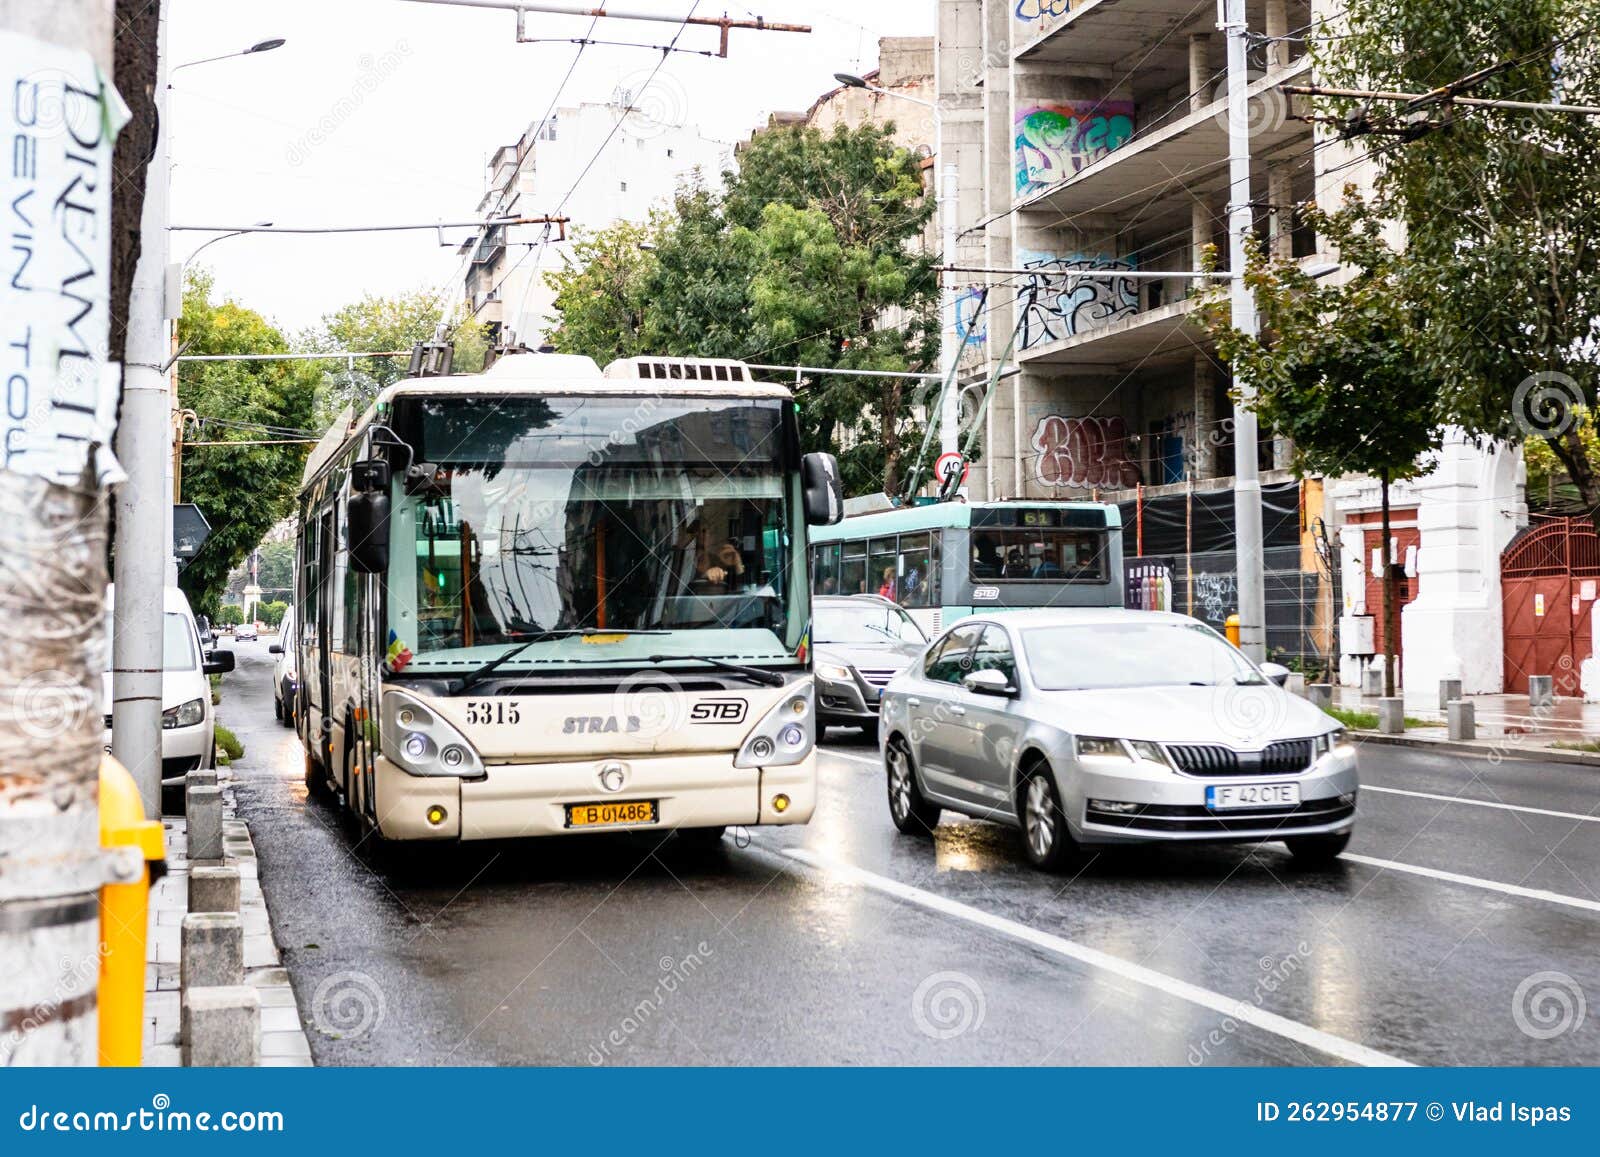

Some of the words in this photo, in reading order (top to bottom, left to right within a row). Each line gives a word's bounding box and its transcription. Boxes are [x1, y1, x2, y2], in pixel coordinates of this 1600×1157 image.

[1024, 512, 1049, 526] 61
[466, 702, 520, 725] 5315
[690, 702, 744, 721] STB
[562, 716, 618, 734] STRA
[1240, 788, 1257, 802] 42
[1260, 786, 1292, 802] CTE
